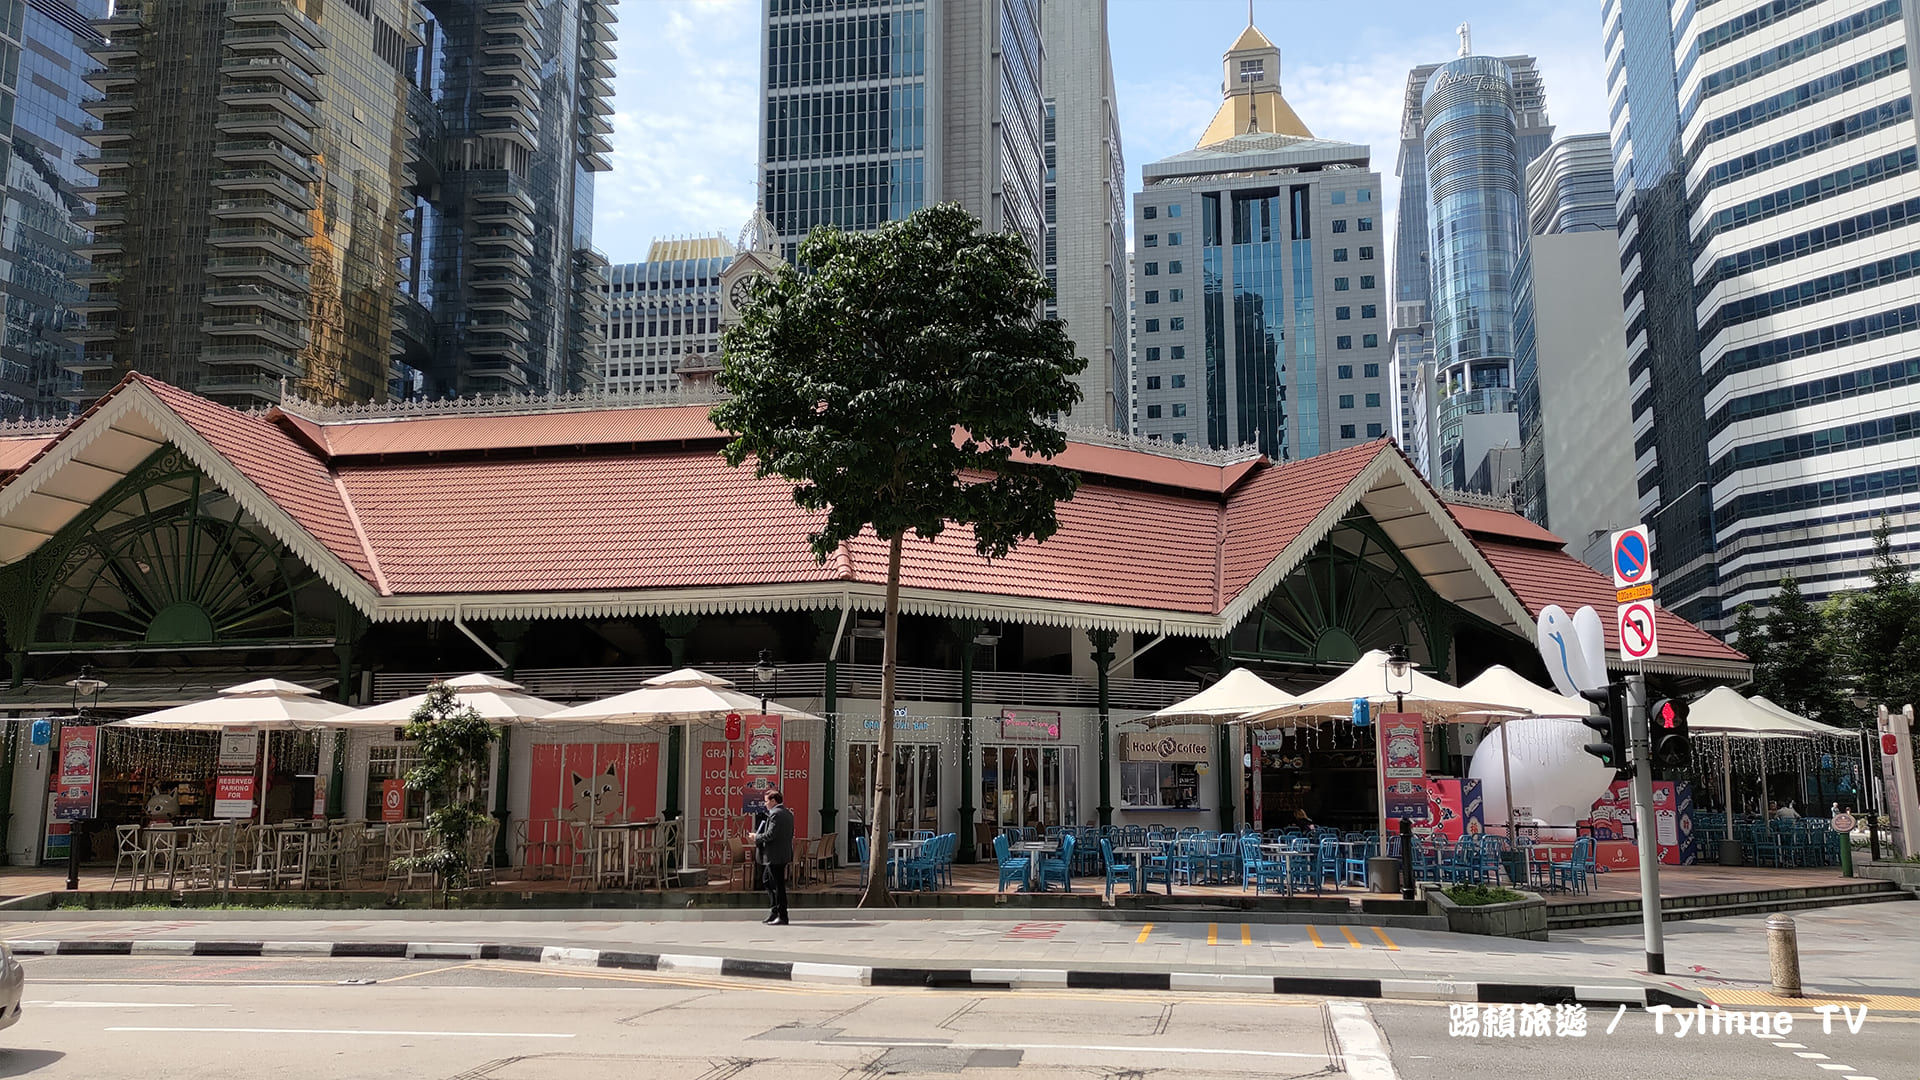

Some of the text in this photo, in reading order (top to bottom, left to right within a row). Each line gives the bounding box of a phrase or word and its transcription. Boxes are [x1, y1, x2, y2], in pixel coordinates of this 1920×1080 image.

[1132, 742, 1207, 754] Hook Coffee
[705, 769, 740, 779] LOCAL
[783, 769, 808, 779] EERS
[704, 807, 738, 817] LOCAL
